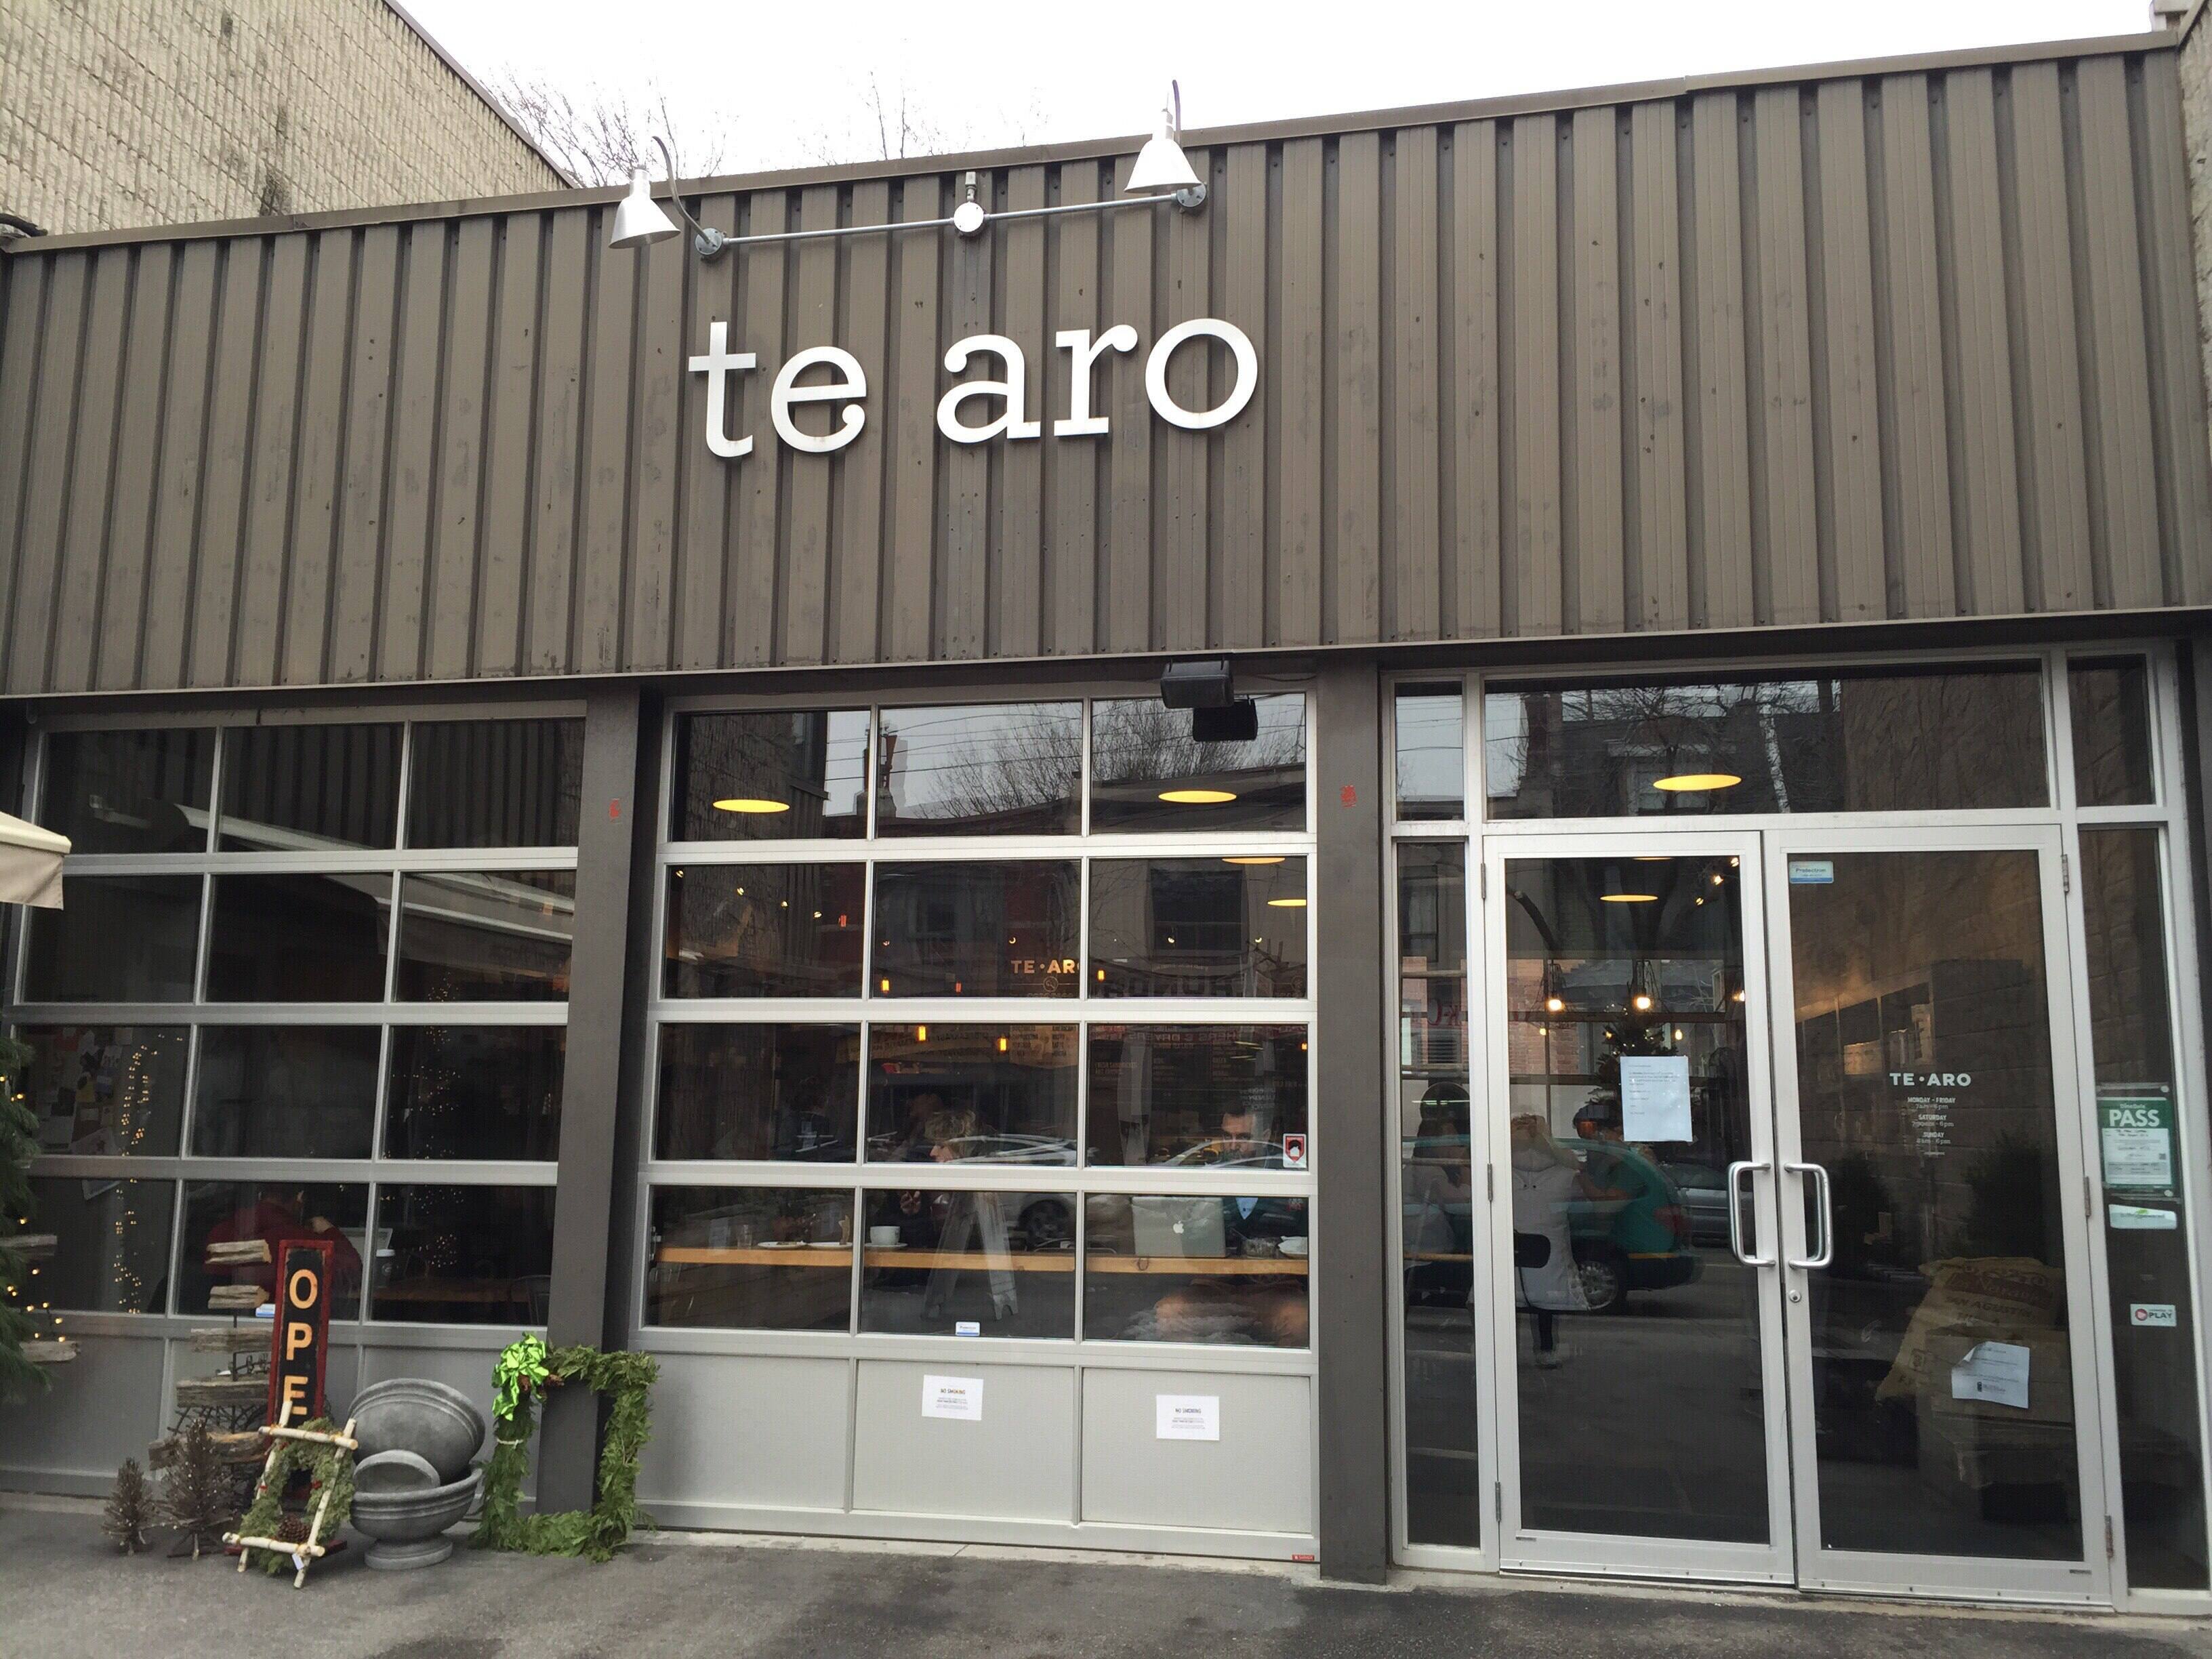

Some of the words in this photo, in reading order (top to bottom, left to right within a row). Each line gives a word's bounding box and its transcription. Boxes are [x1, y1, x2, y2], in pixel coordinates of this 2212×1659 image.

[689, 321, 867, 458] te
[937, 318, 1258, 444] aro
[2109, 1109, 2160, 1126] PASS
